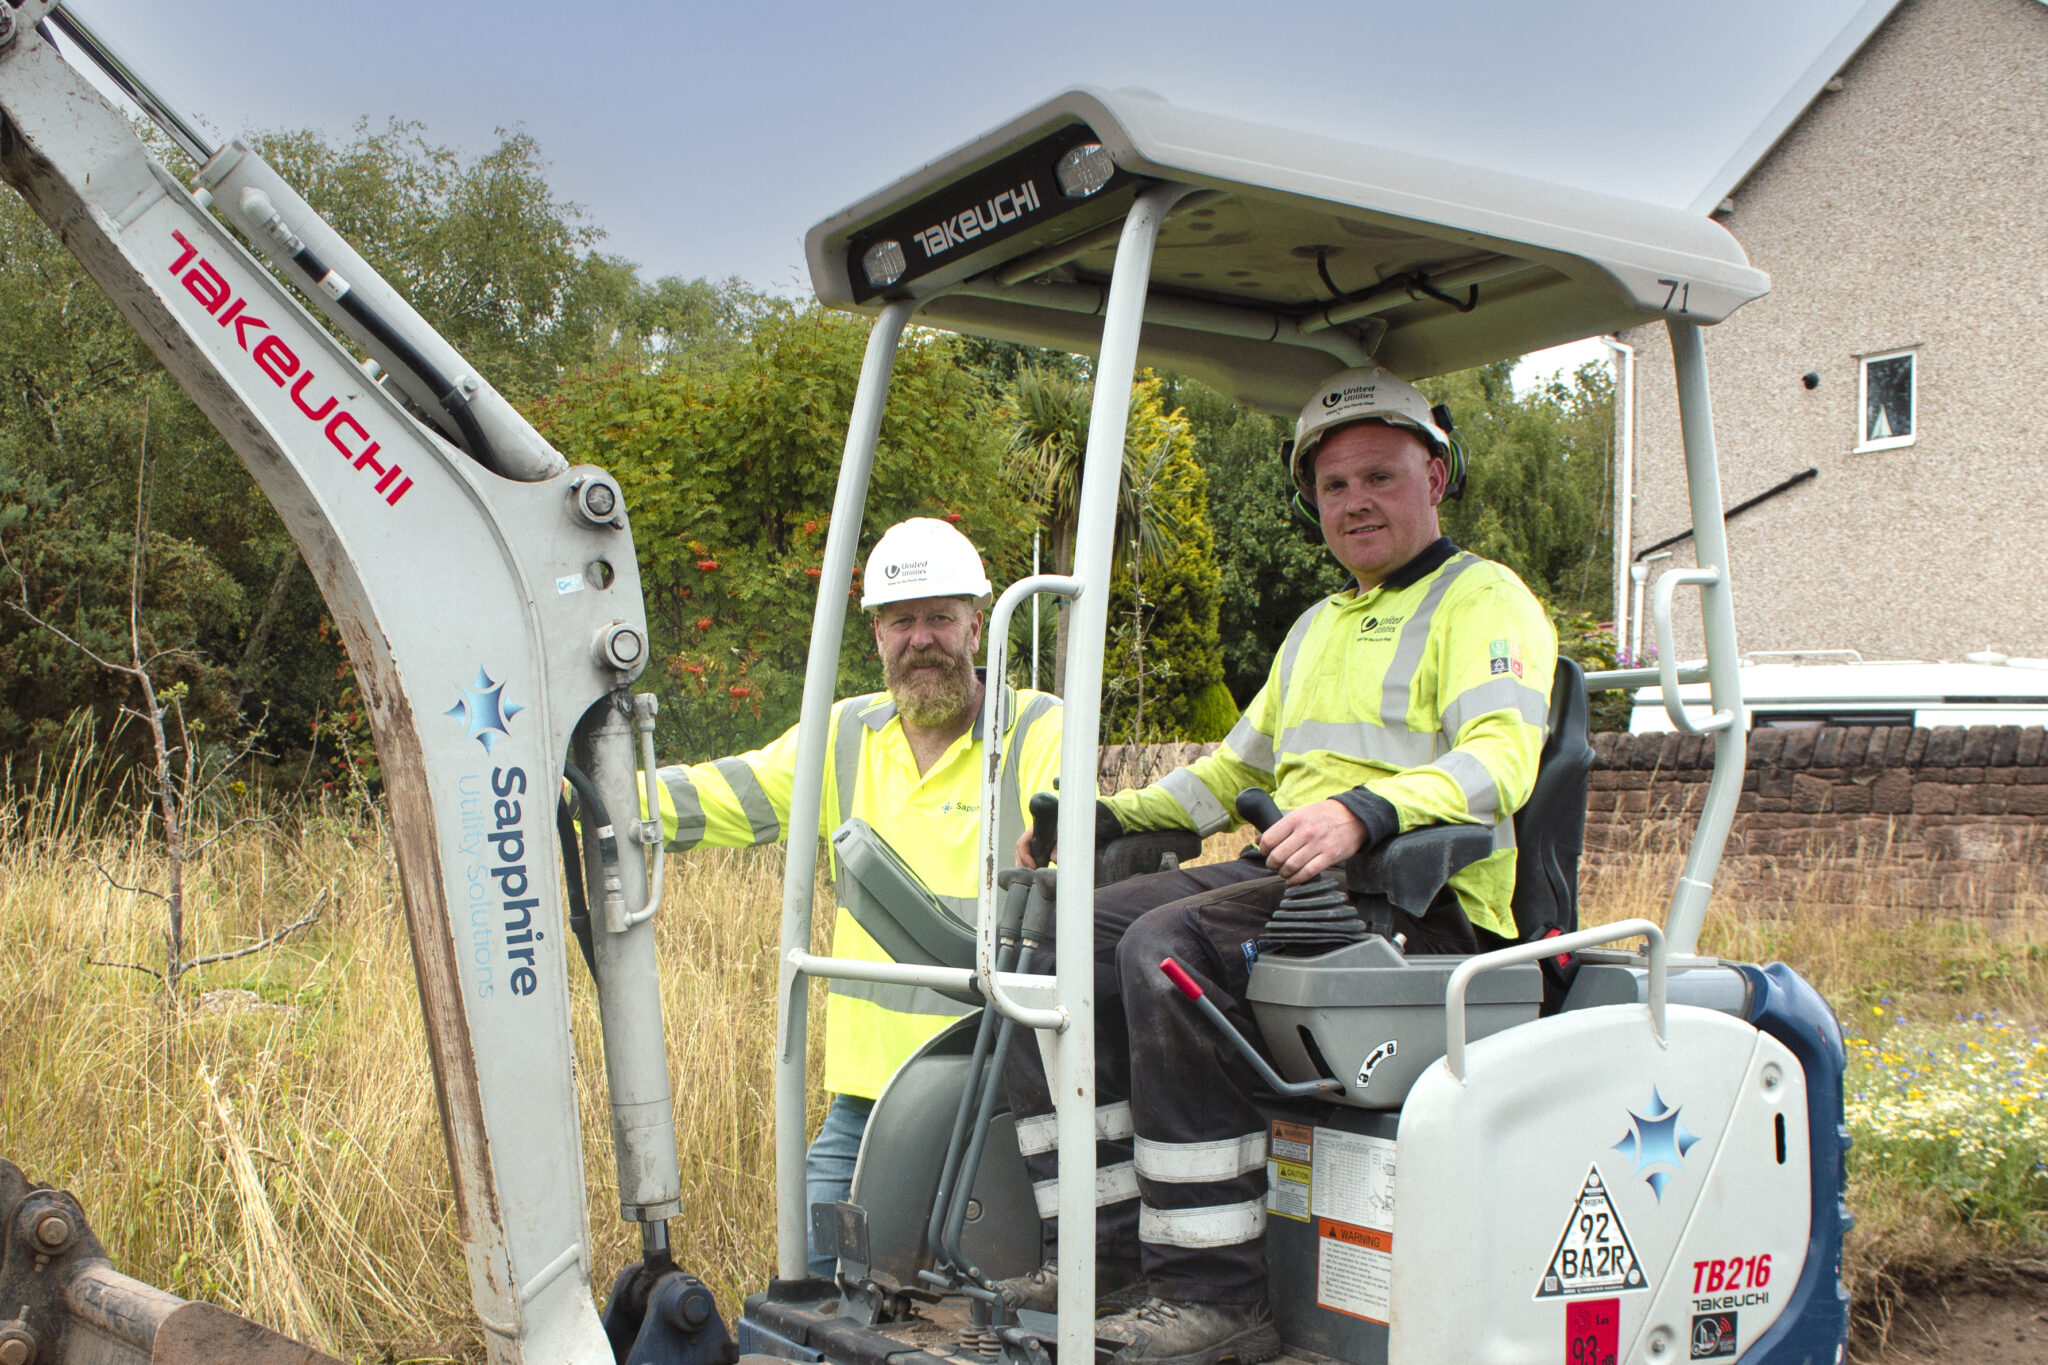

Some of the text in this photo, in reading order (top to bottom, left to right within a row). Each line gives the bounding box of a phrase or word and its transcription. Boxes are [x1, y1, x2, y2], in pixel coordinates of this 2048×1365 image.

[914, 180, 1040, 257] TAKEUCHI
[1657, 279, 1688, 313] 71
[168, 229, 413, 506] TAKEUCHI
[1343, 385, 1375, 395] United
[1344, 393, 1375, 402] Utilities
[901, 560, 928, 570] United
[1379, 616, 1404, 626] United
[459, 774, 493, 1000] Utility Solutions
[488, 766, 544, 996] Sapphire
[1287, 1167, 1309, 1180] CAUTION
[1340, 1228, 1381, 1248] WARNING
[1580, 1212, 1610, 1243] 92
[1561, 1244, 1625, 1279] BA2R
[1692, 1254, 1772, 1294] TB216
[1692, 1292, 1769, 1311] TAKEUCHI
[1573, 1335, 1598, 1365] 93
